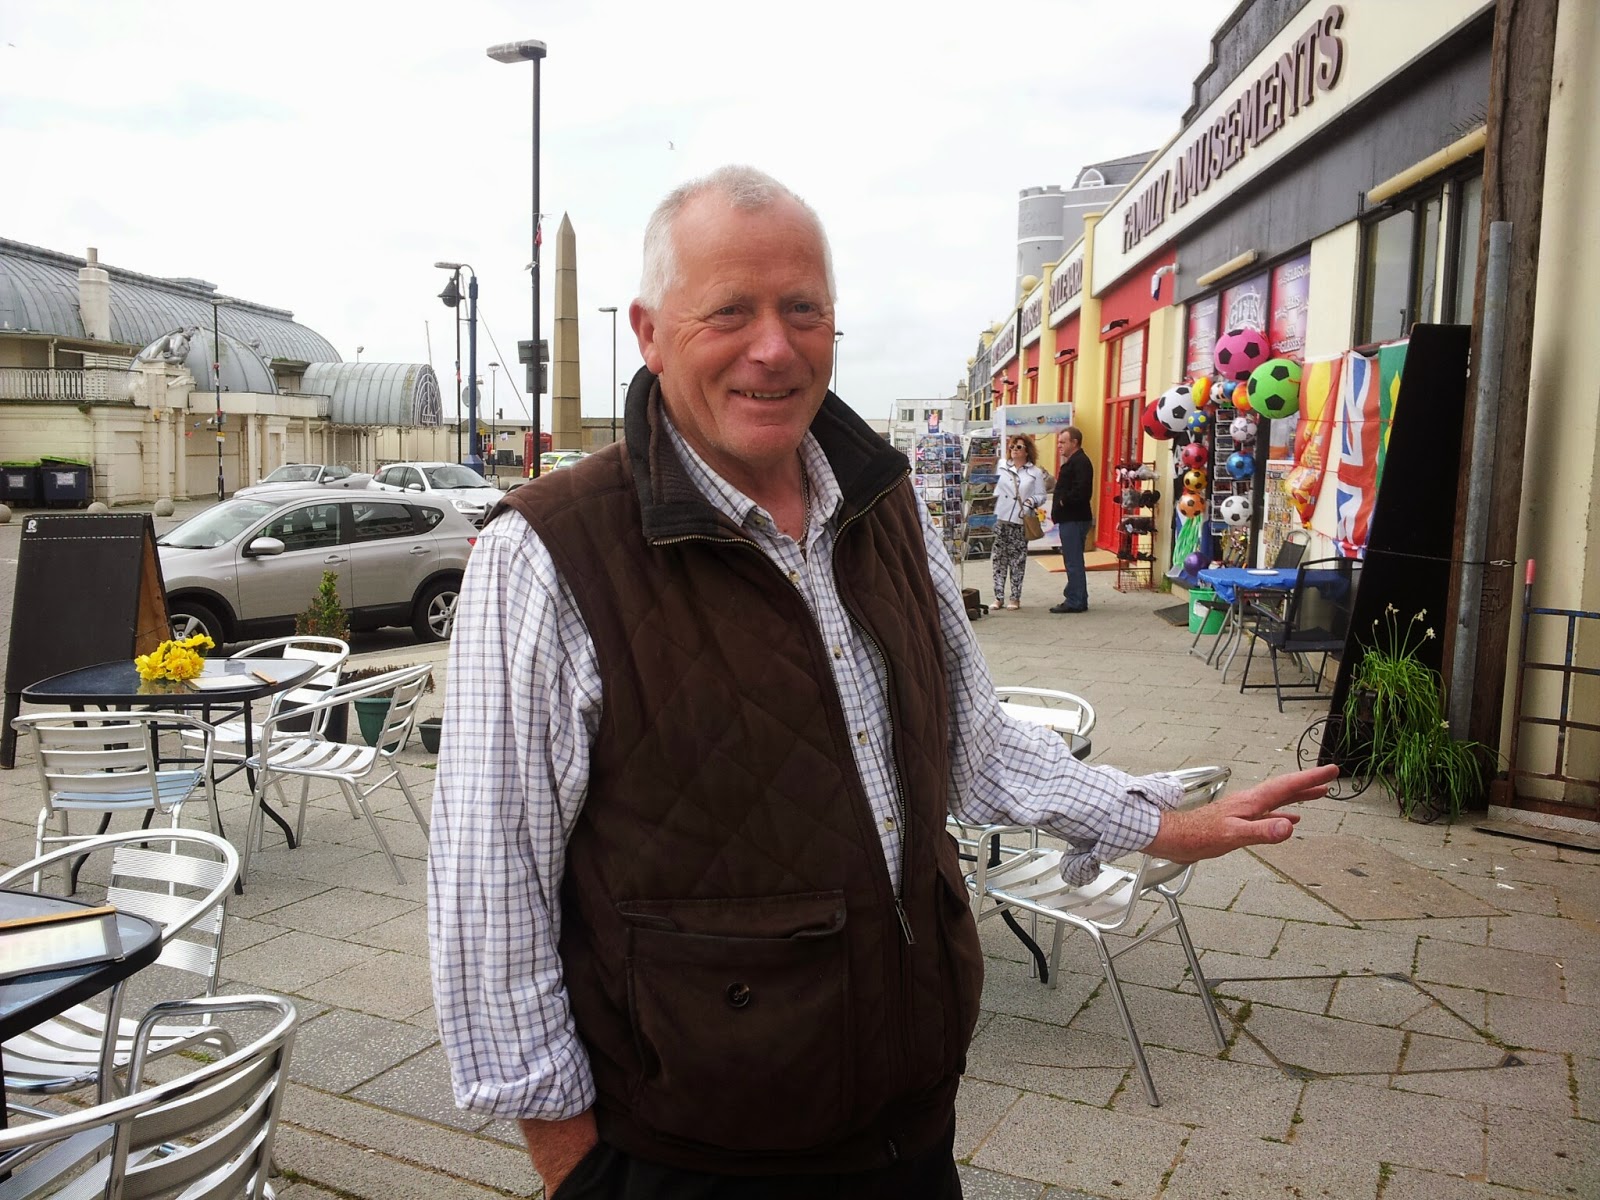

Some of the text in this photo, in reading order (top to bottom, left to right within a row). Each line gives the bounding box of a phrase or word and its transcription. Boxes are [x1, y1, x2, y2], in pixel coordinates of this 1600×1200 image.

[1122, 4, 1344, 254] FAMILY AMUSEMENTS
[1229, 293, 1260, 330] GIFTS
